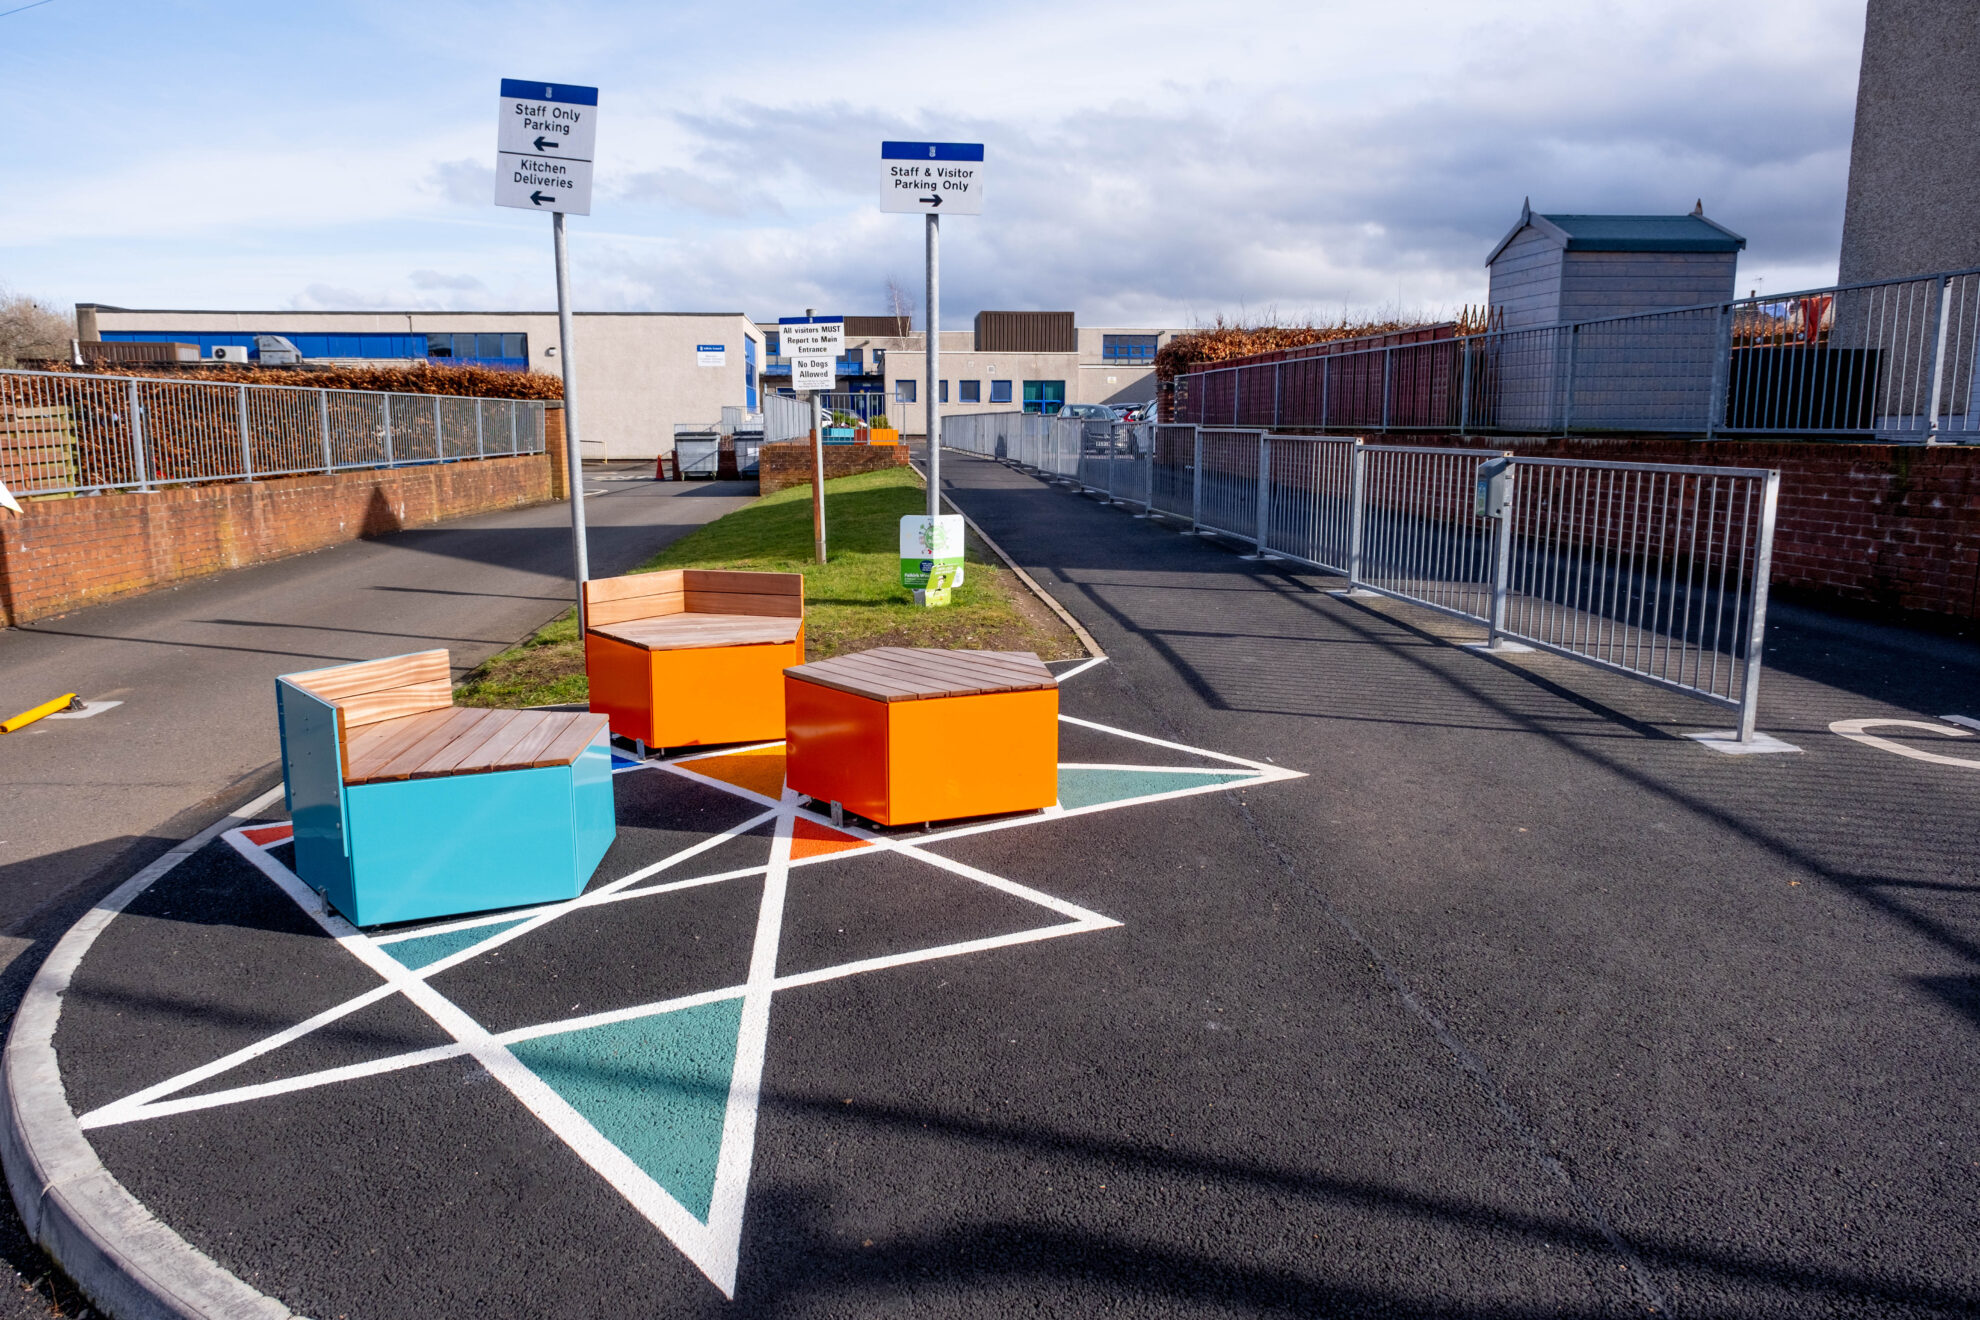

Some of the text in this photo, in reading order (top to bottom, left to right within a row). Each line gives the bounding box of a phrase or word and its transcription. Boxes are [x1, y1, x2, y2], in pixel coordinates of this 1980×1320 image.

[515, 103, 581, 123] Staff Only
[524, 118, 570, 135] Parking
[520, 159, 566, 174] Kitchen
[890, 166, 974, 178] Staff & Visitor
[513, 172, 574, 189] Deliveries
[894, 179, 969, 192] Parking Only
[821, 325, 841, 333] MUST
[787, 337, 809, 345] Report
[797, 360, 829, 368] No Dogs
[799, 370, 829, 378] Allowed
